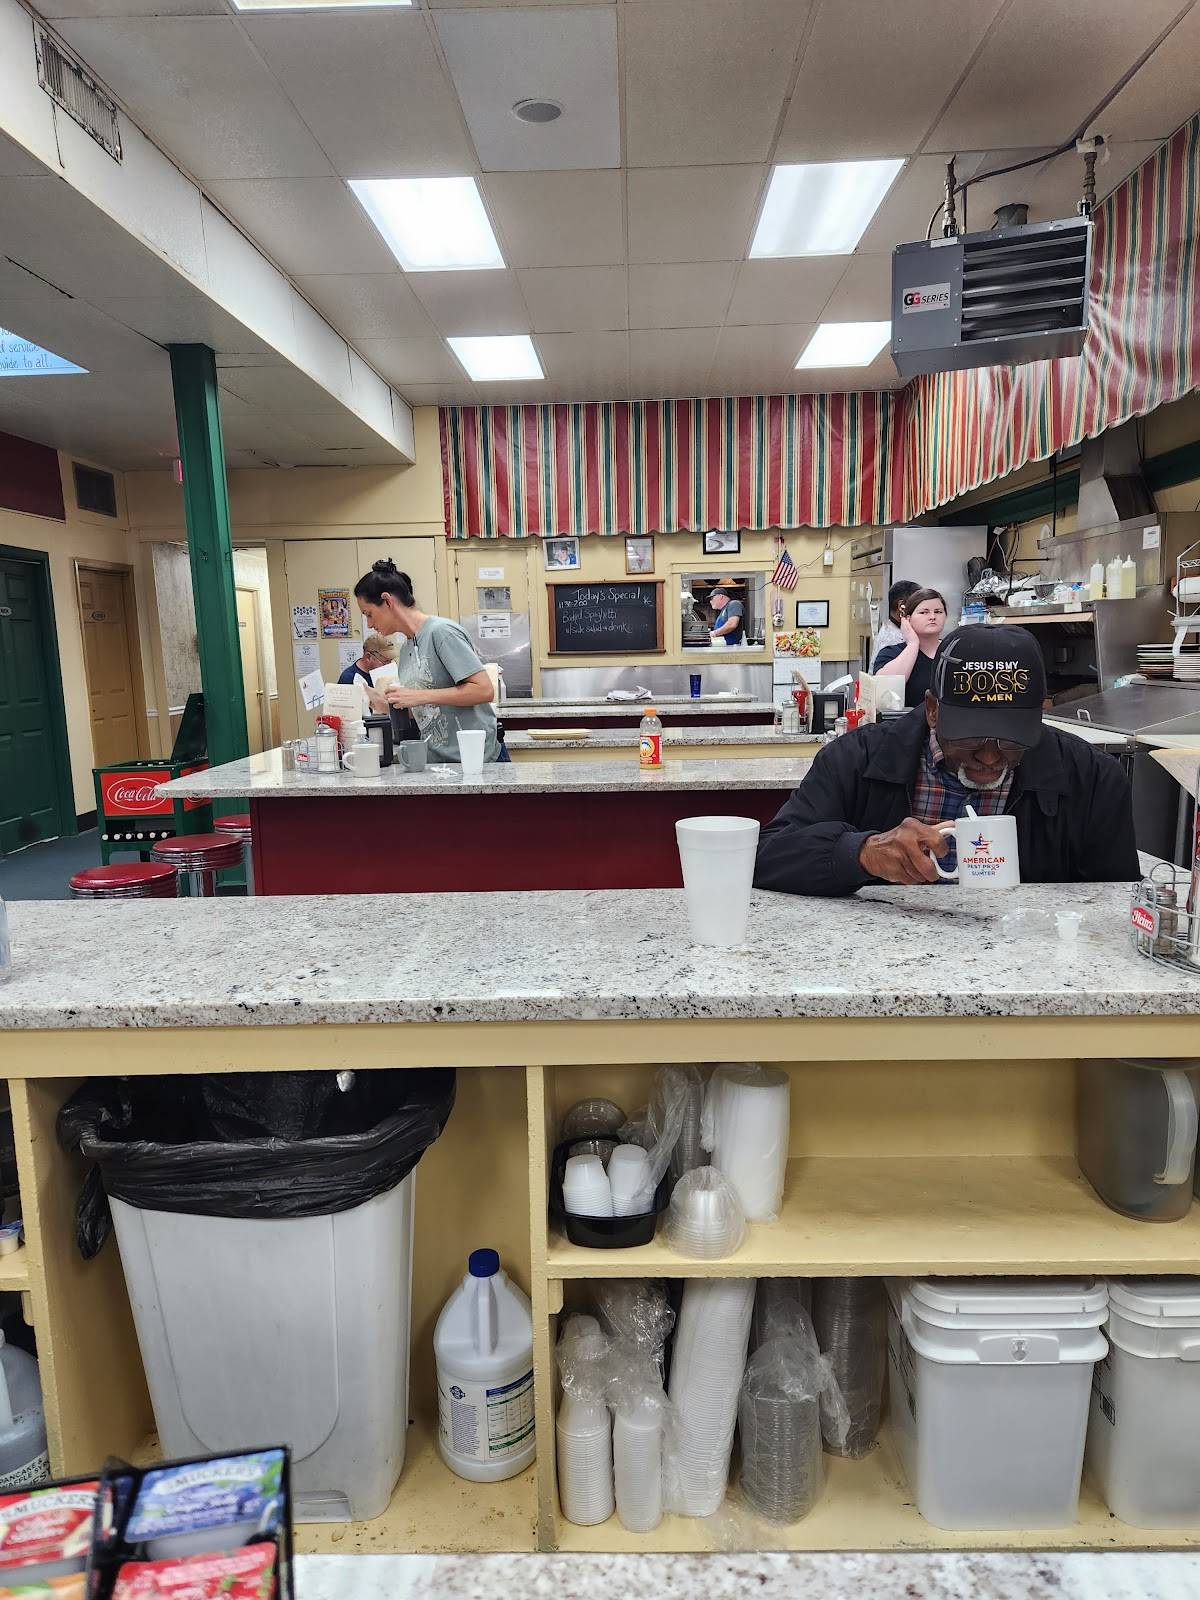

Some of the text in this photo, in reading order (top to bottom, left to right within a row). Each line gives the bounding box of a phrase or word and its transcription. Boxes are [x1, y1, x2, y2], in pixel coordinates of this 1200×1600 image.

[921, 292, 949, 304] SERIES
[23, 354, 33, 368] to
[572, 586, 641, 604] Today's Special
[962, 661, 1019, 670] JESUS IS MY
[953, 669, 1030, 694] BOSS
[971, 694, 1013, 702] A-MEN
[1132, 909, 1154, 930] Heinz
[0, 1462, 36, 1484] PANCAKE
